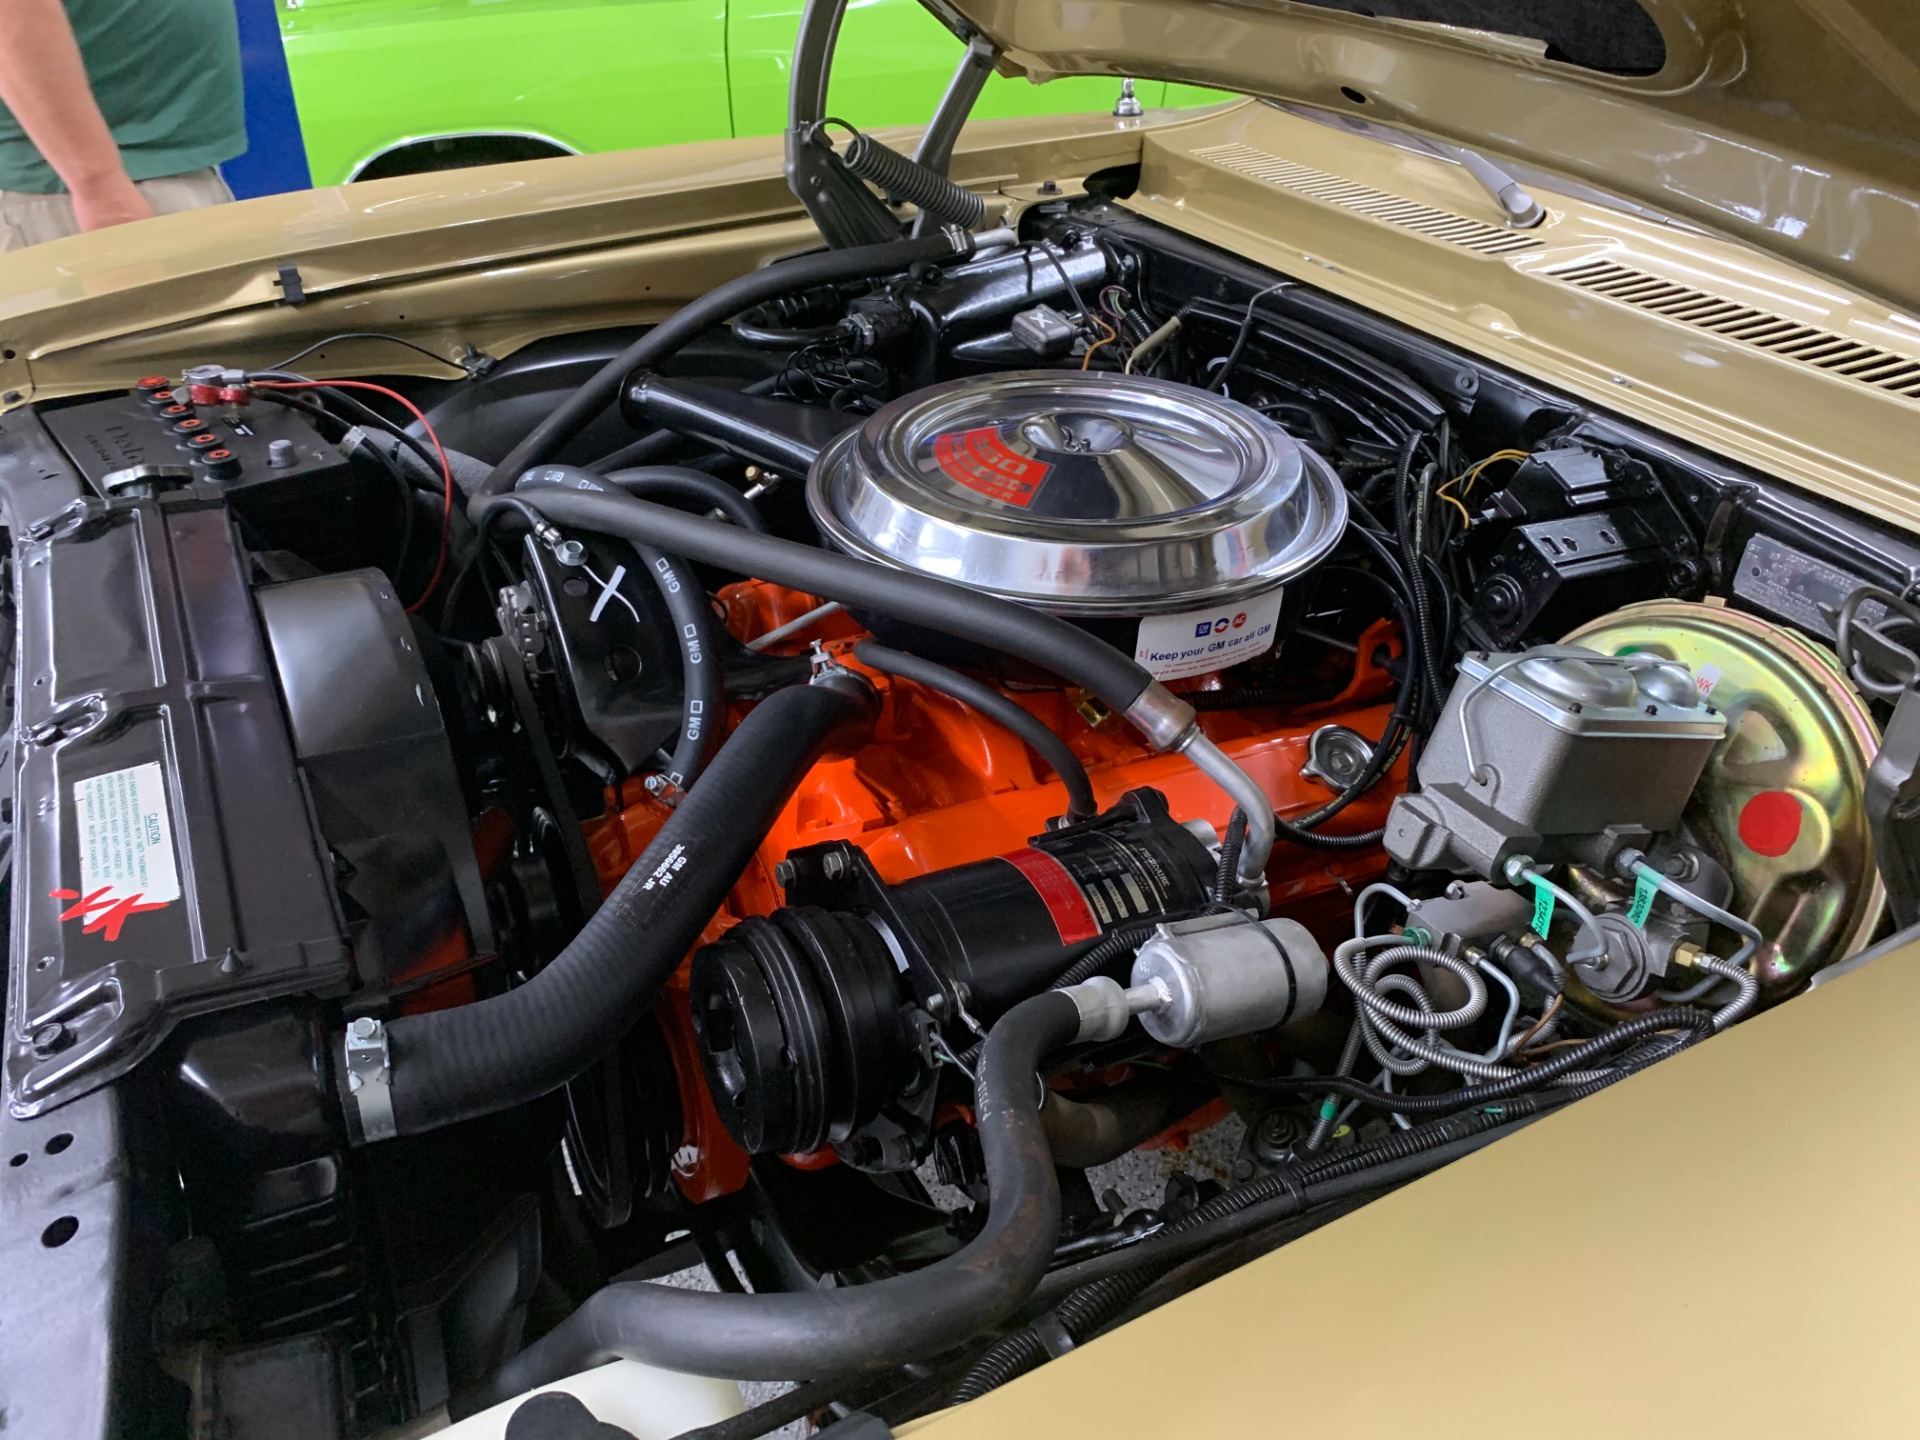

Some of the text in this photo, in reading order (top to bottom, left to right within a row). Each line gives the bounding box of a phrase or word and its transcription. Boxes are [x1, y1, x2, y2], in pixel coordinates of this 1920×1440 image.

[662, 570, 681, 594] GM
[690, 639, 703, 665] GM
[1150, 650, 1179, 663] Keep
[1180, 648, 1206, 662] your
[1208, 640, 1226, 653] GM
[1228, 637, 1243, 649] car
[1244, 630, 1256, 642] all
[1257, 623, 1272, 638] GM
[686, 716, 702, 741] GM
[146, 813, 161, 845] CAUTION
[659, 856, 687, 886] GM AU
[1139, 847, 1170, 887] FRIGIDAIRE
[642, 878, 656, 890] JR
